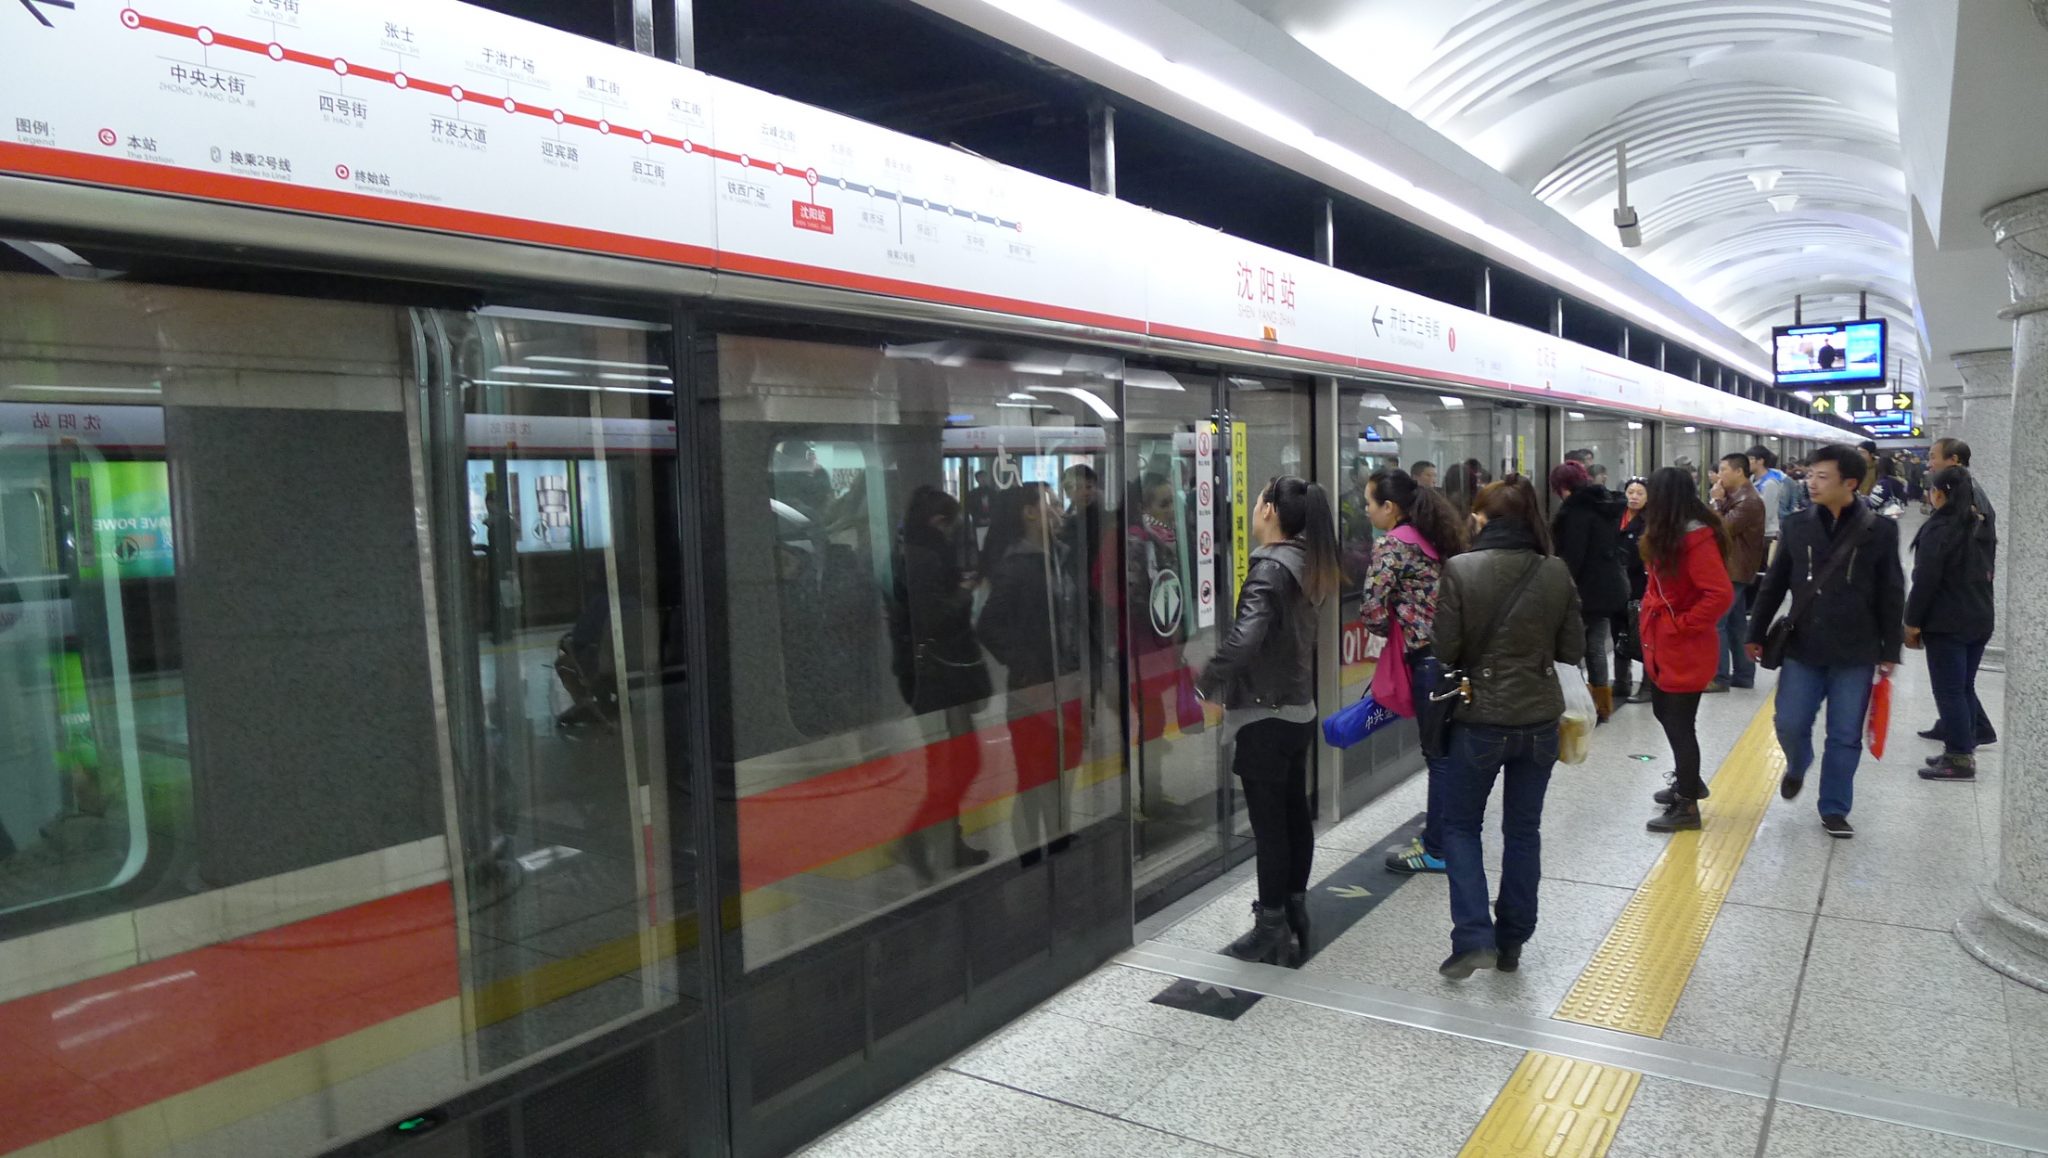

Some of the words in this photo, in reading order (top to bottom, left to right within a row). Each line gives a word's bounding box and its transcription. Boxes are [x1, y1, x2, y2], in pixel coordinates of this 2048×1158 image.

[384, 21, 414, 43] 张士
[482, 47, 535, 75] 于洪广场
[170, 64, 245, 96] 中央大街
[319, 95, 367, 120] 四号街
[430, 118, 487, 144] 开发大道
[127, 135, 157, 152] 本站
[541, 141, 579, 162] 迎宾路
[230, 150, 292, 173] 换乘2号线
[632, 160, 665, 180] 启工街
[355, 170, 390, 187] 终始站
[1236, 260, 1295, 310] 沈阳站
